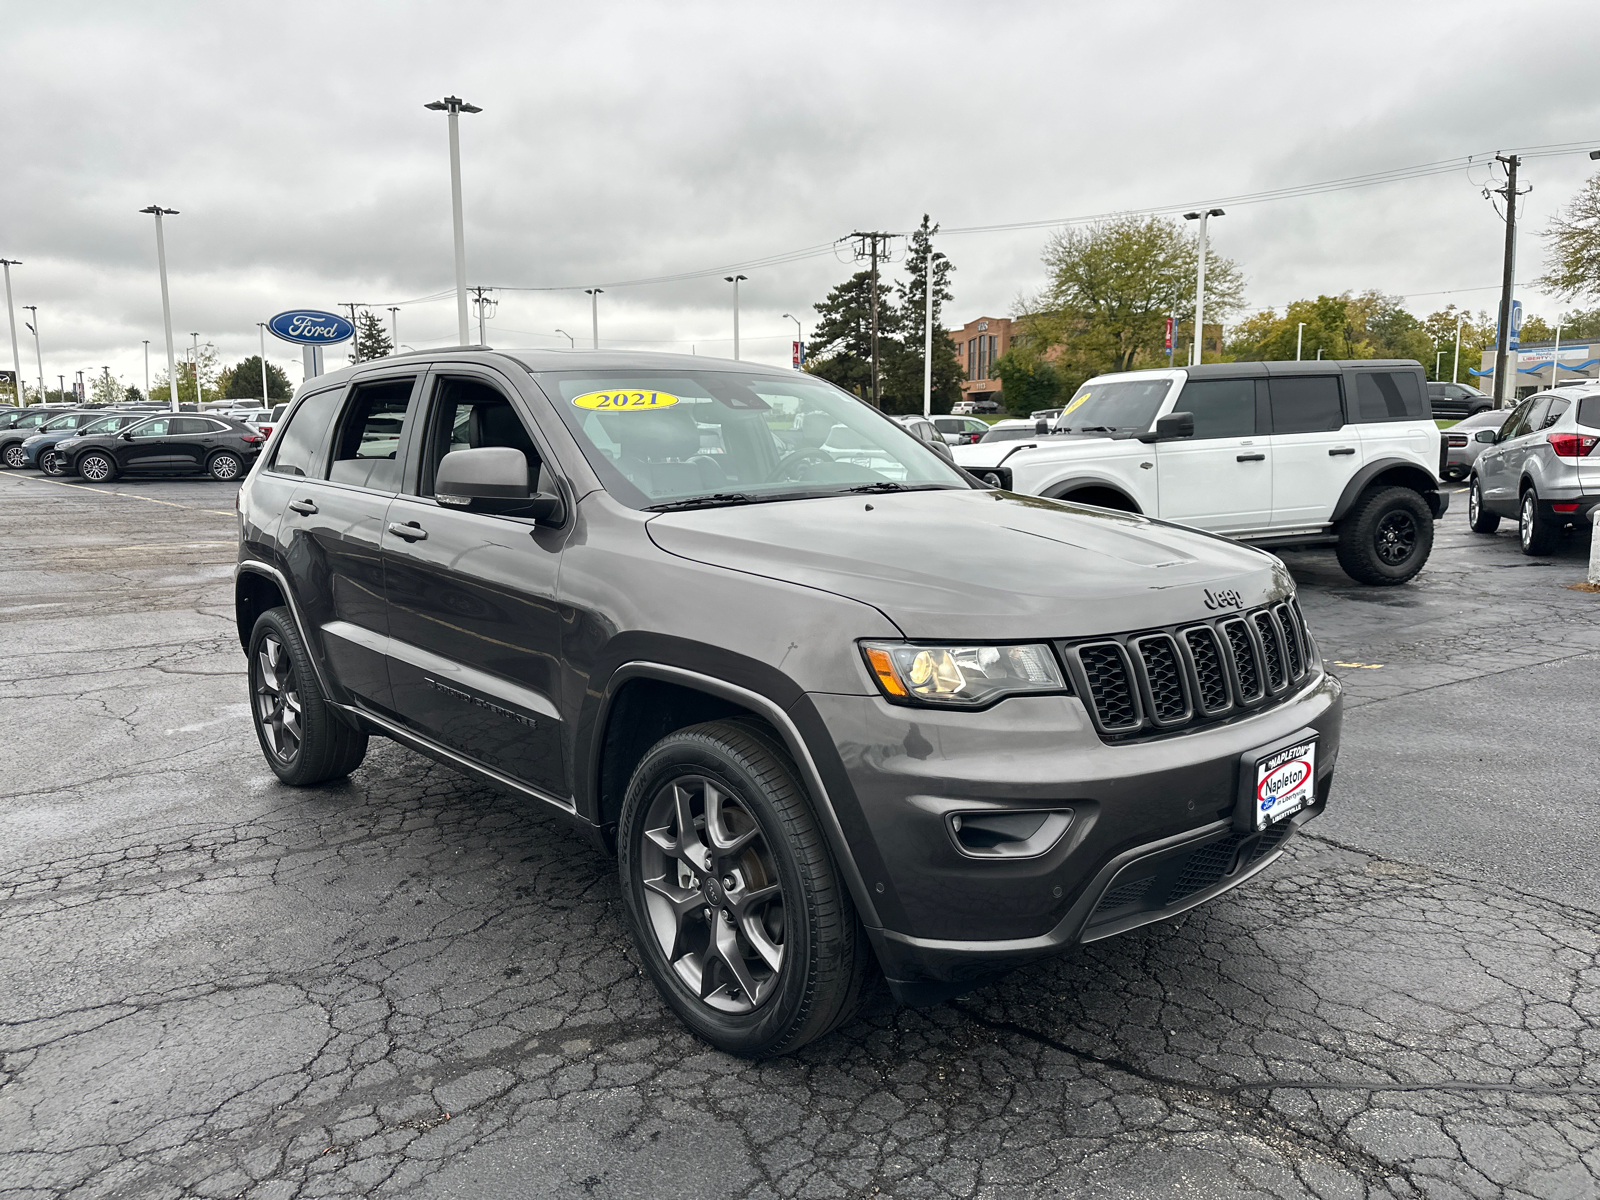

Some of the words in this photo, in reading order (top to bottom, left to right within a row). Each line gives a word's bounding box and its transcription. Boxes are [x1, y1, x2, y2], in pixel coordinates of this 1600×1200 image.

[288, 315, 338, 338] Ford
[596, 392, 660, 408] 2021
[1203, 588, 1243, 610] Jeep
[1270, 745, 1307, 769] NAPLETON
[1265, 769, 1303, 796] Napleton
[1282, 788, 1307, 804] Libertyville
[620, 774, 647, 864] SCORPION
[1272, 804, 1302, 824] LIBERTYVILLE
